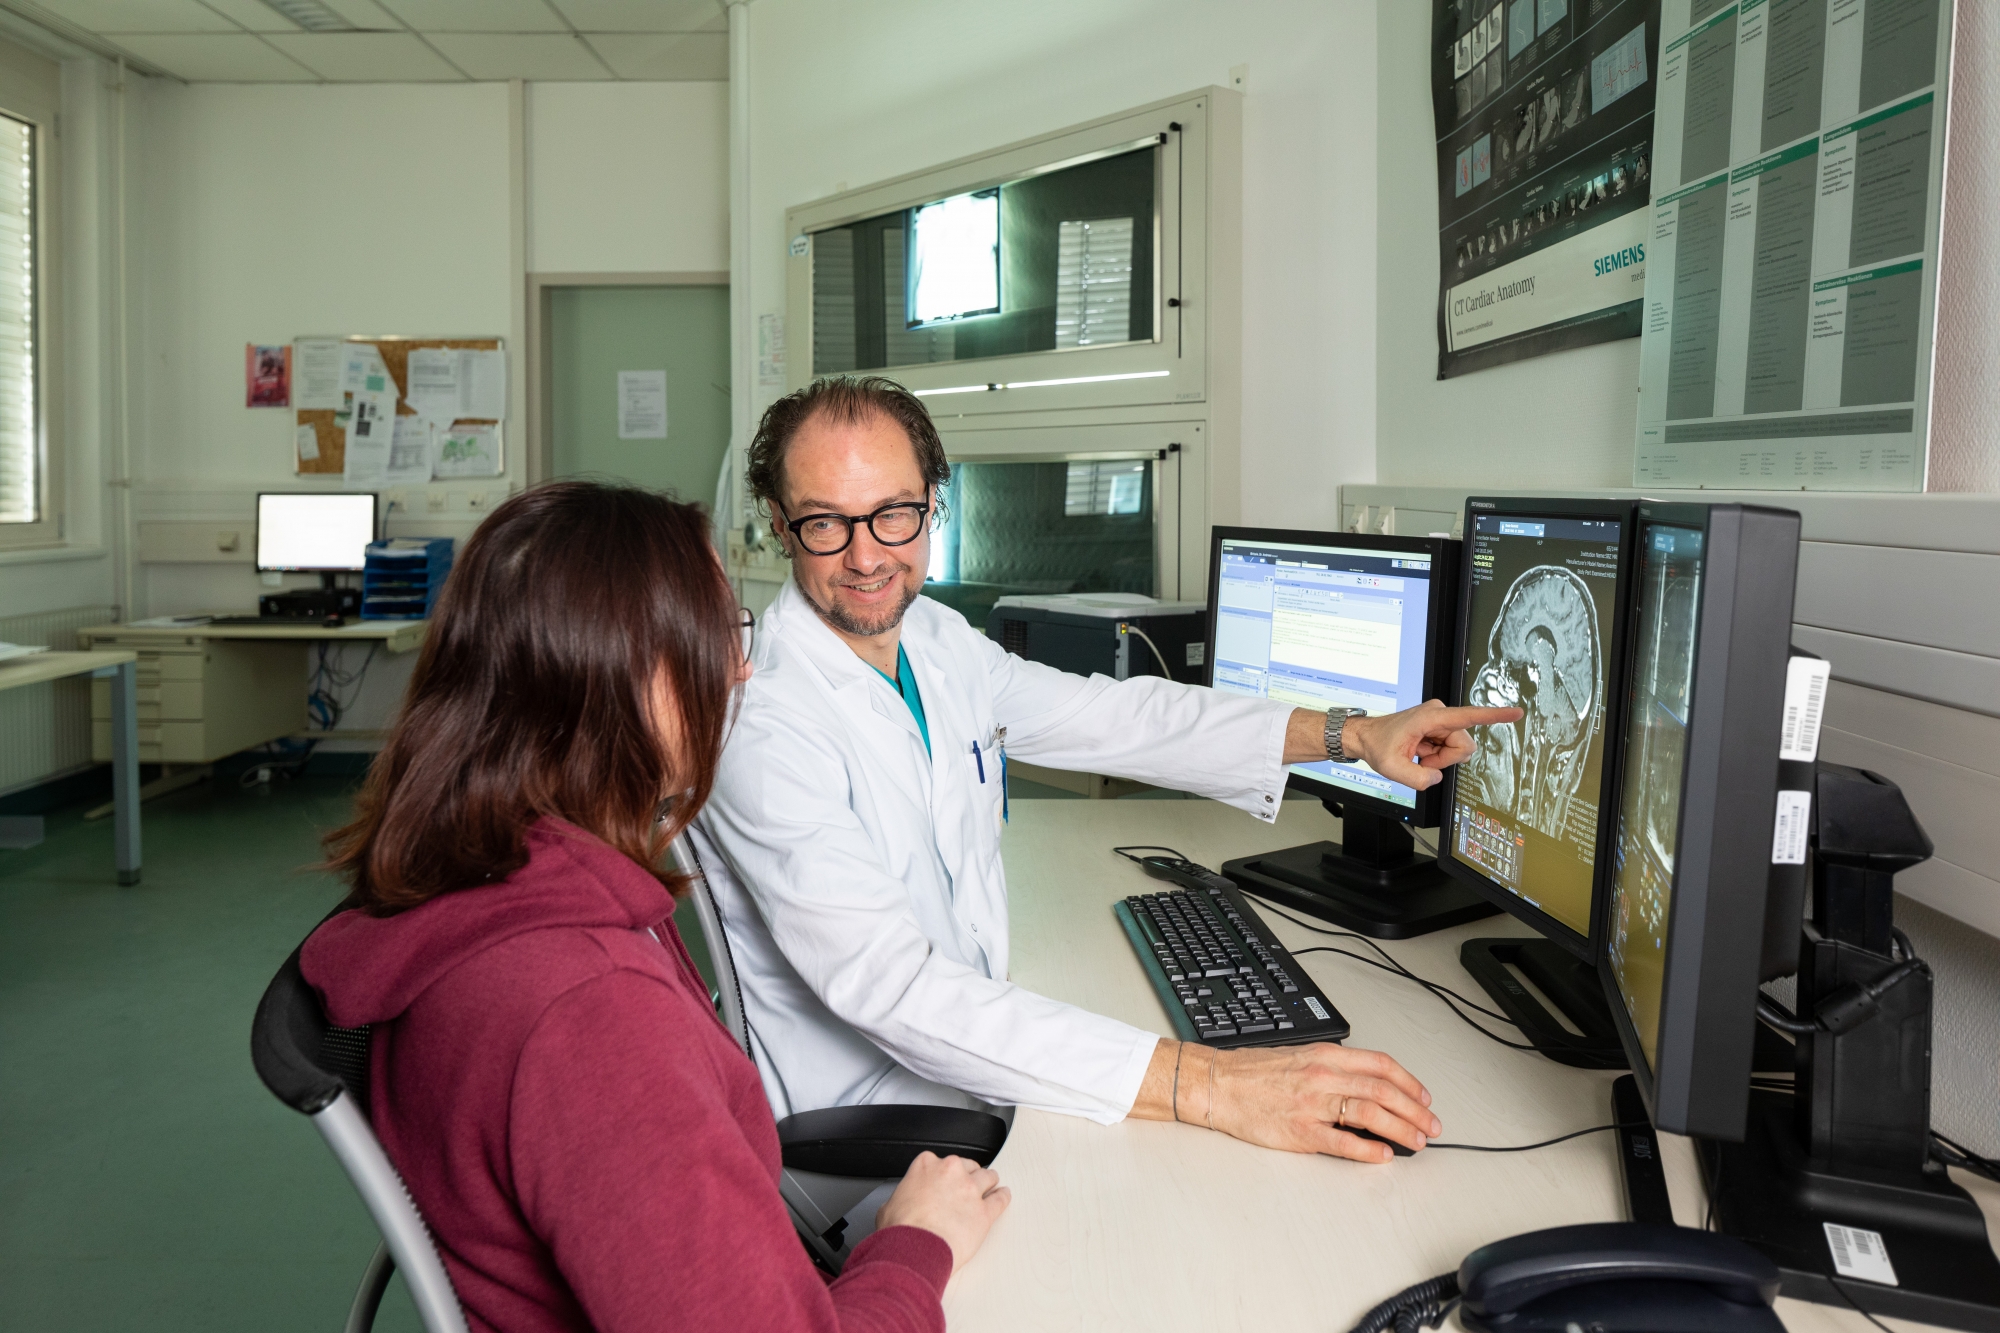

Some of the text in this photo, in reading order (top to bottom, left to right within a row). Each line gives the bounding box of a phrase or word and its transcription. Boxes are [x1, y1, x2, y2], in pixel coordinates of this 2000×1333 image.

[1594, 244, 1645, 276] SIEMENS
[1847, 273, 1872, 283] Reaktionen
[1454, 276, 1535, 317] CT Cardiac Anatomy
